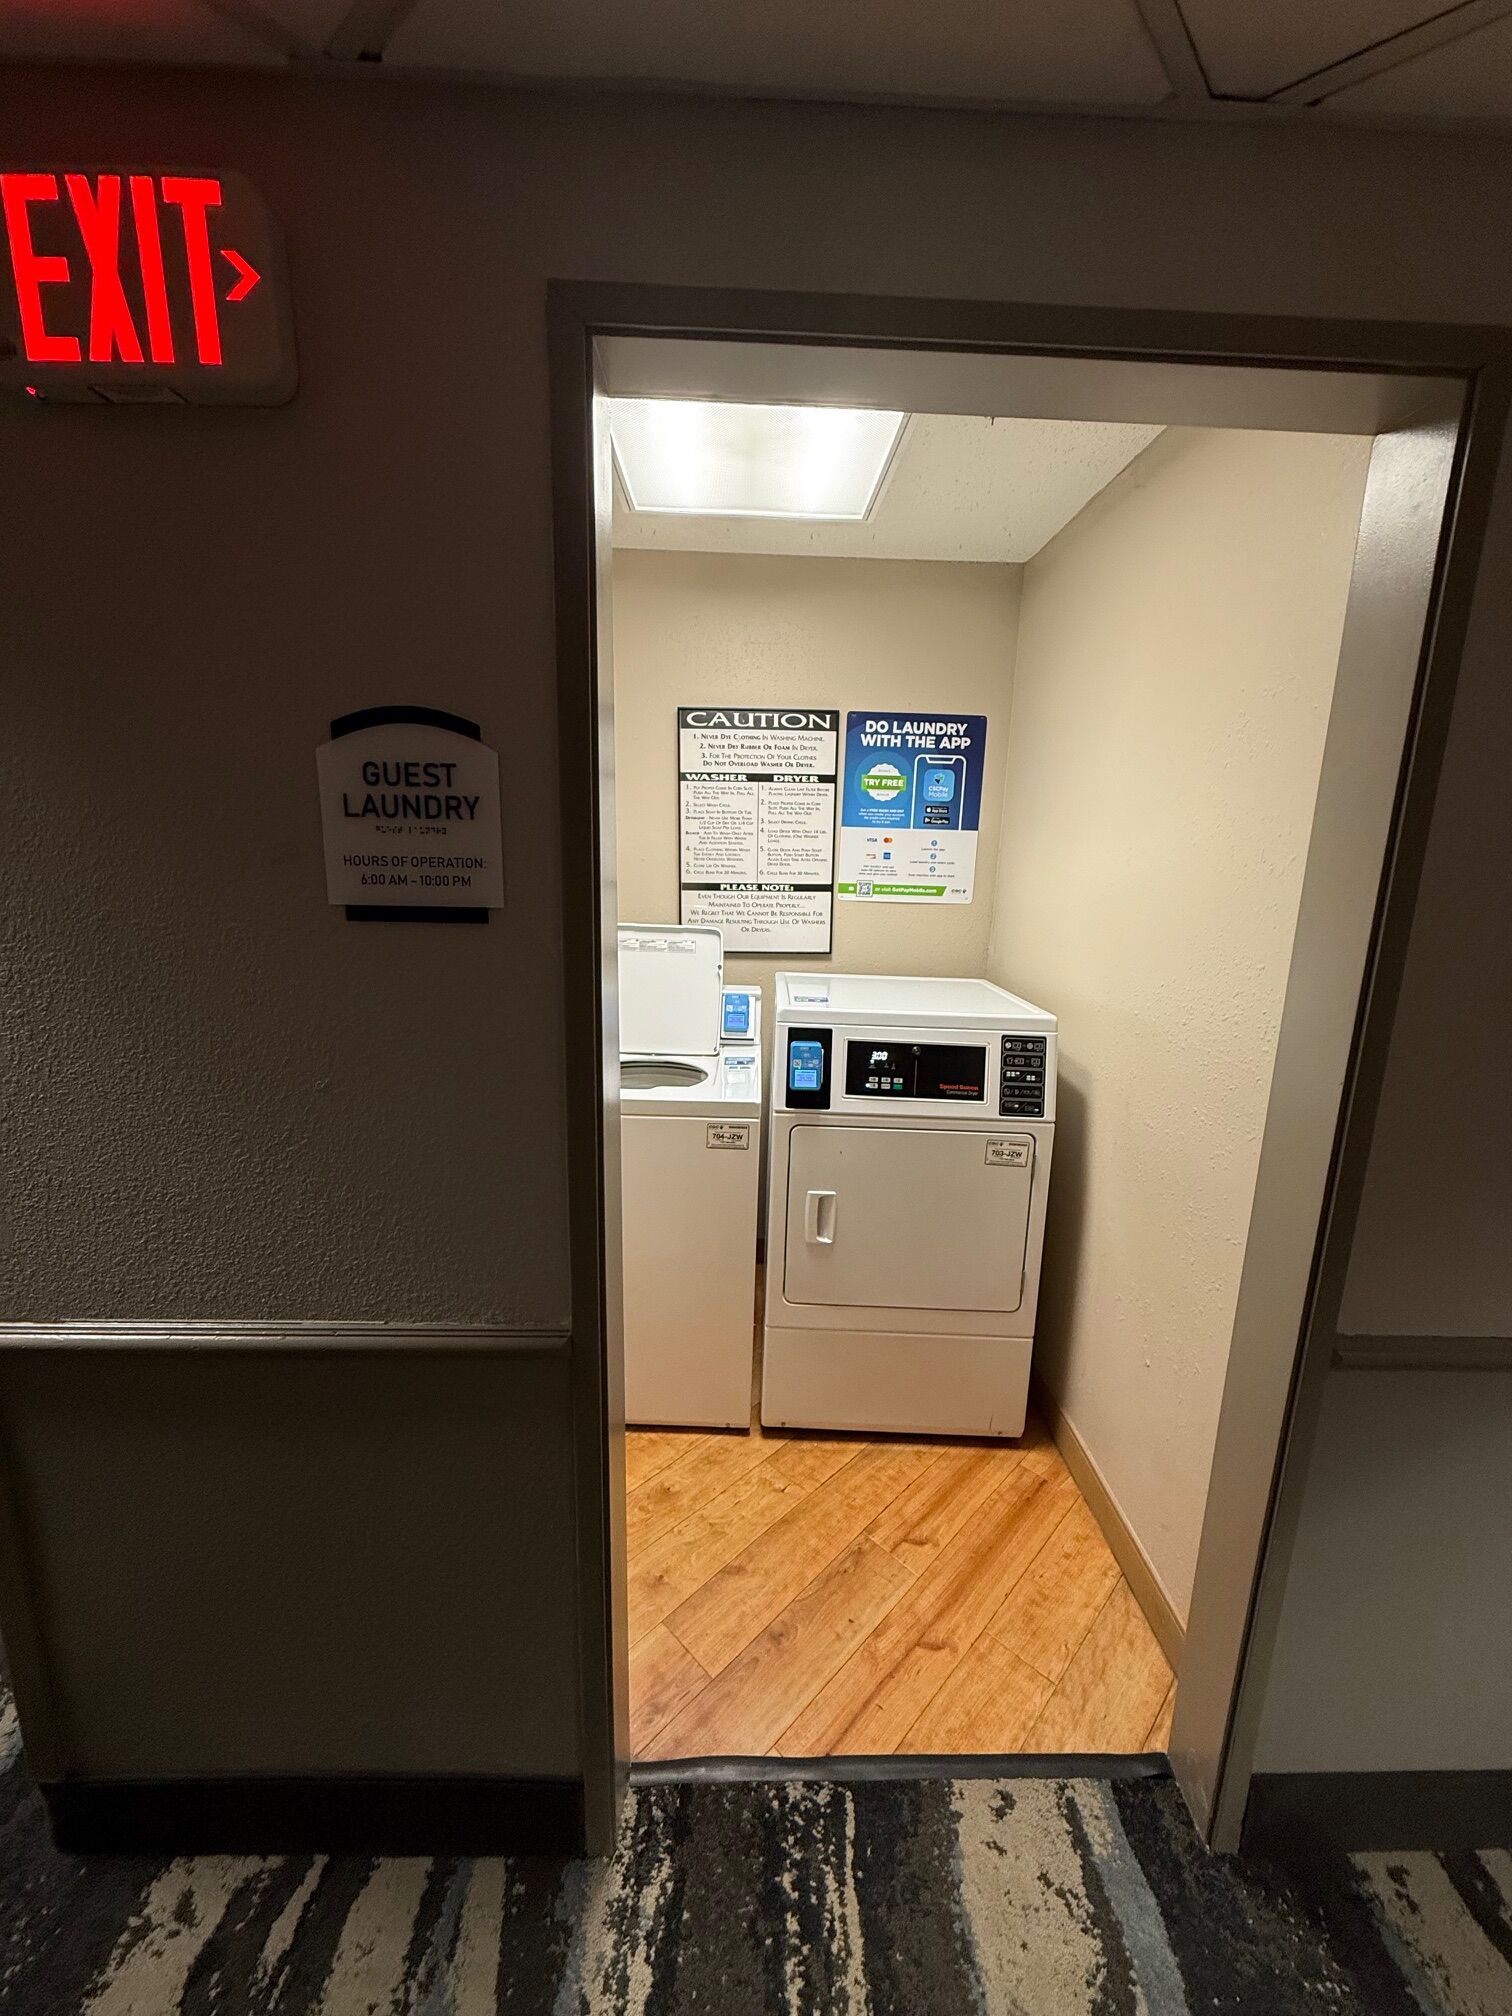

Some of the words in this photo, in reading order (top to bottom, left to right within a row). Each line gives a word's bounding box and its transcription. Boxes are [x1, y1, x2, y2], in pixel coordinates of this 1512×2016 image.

[0, 174, 222, 365] EXIT
[686, 712, 831, 729] CAUTION
[866, 720, 889, 733] DO
[893, 721, 968, 736] LAUNDRY
[861, 734, 901, 747] WITH
[906, 736, 936, 748] THE
[939, 737, 971, 749] APP
[362, 761, 456, 788] GUEST
[864, 778, 880, 786] TRY
[343, 793, 480, 820] LAUNDRY
[344, 855, 388, 866] HOURS
[392, 856, 408, 867] OF
[411, 856, 487, 869] OPERATION:
[361, 874, 385, 885] 6:00
[388, 875, 408, 886] AM
[420, 876, 449, 886] 10:00
[452, 876, 471, 887] PM
